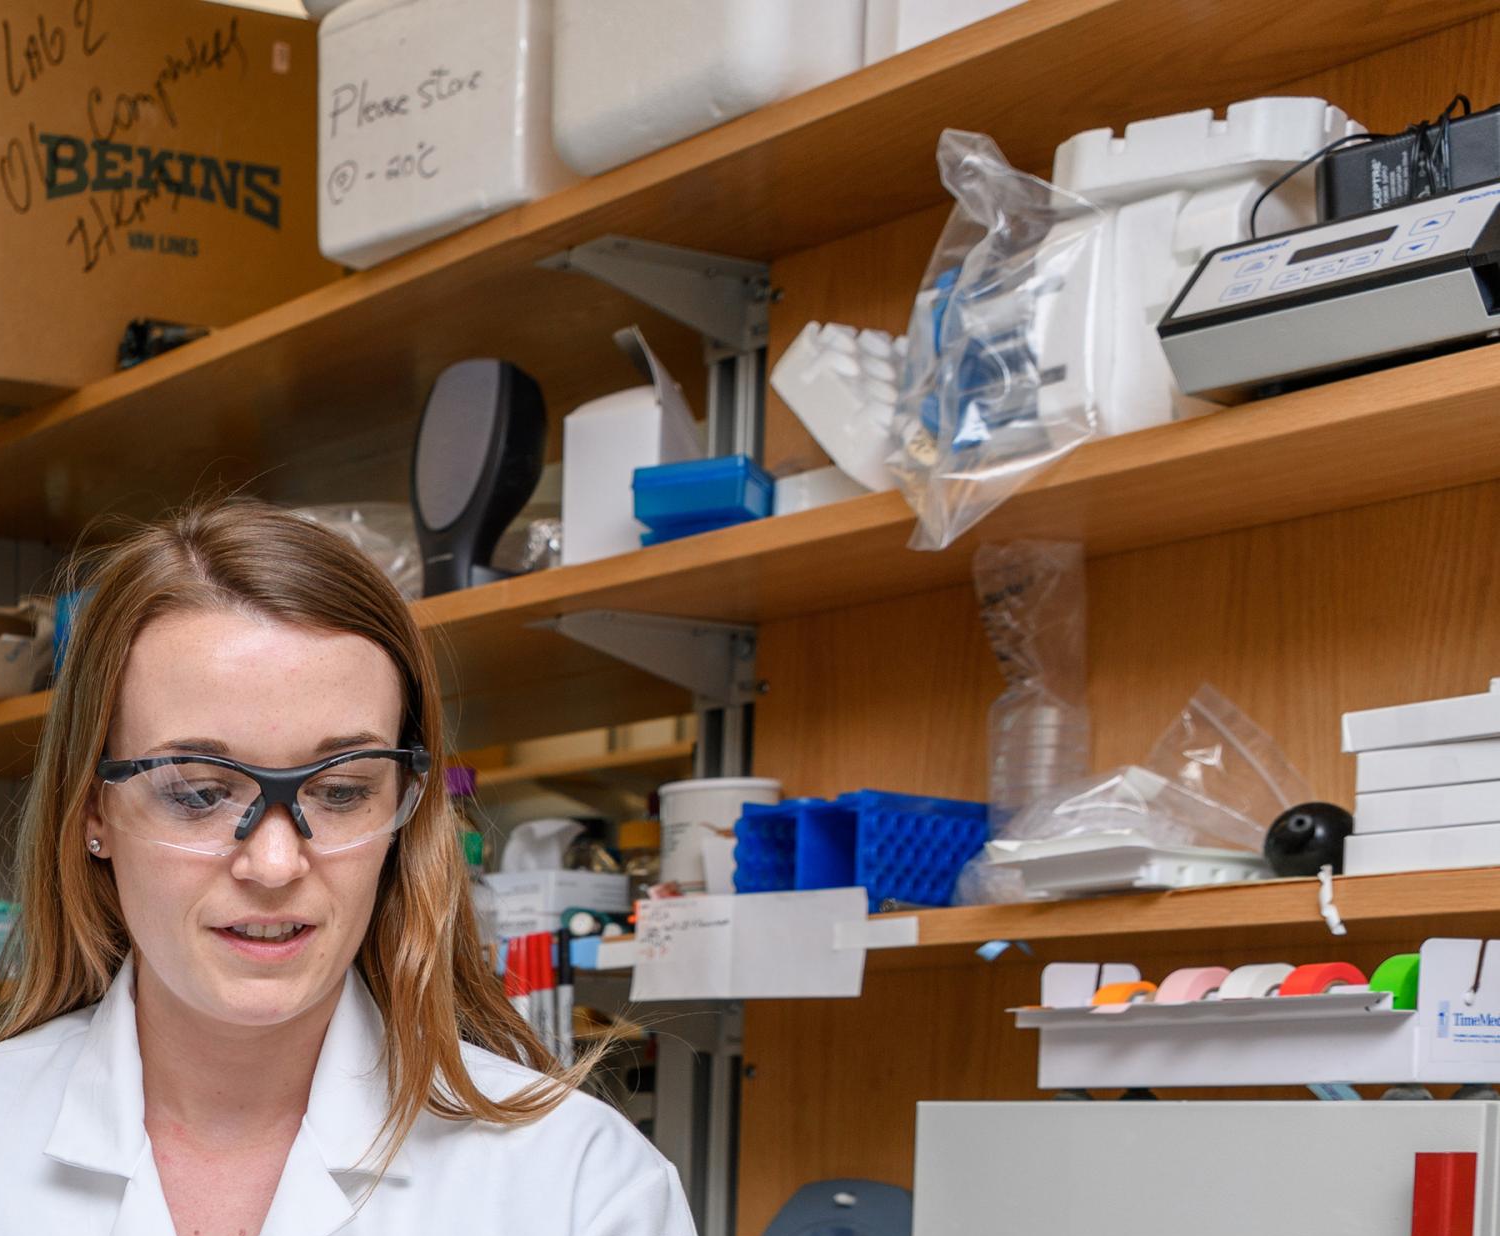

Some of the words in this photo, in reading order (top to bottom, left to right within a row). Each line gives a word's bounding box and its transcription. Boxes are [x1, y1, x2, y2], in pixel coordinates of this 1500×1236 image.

[39, 132, 281, 230] BEKINS
[128, 231, 154, 250] VAN
[159, 234, 199, 257] LINES
